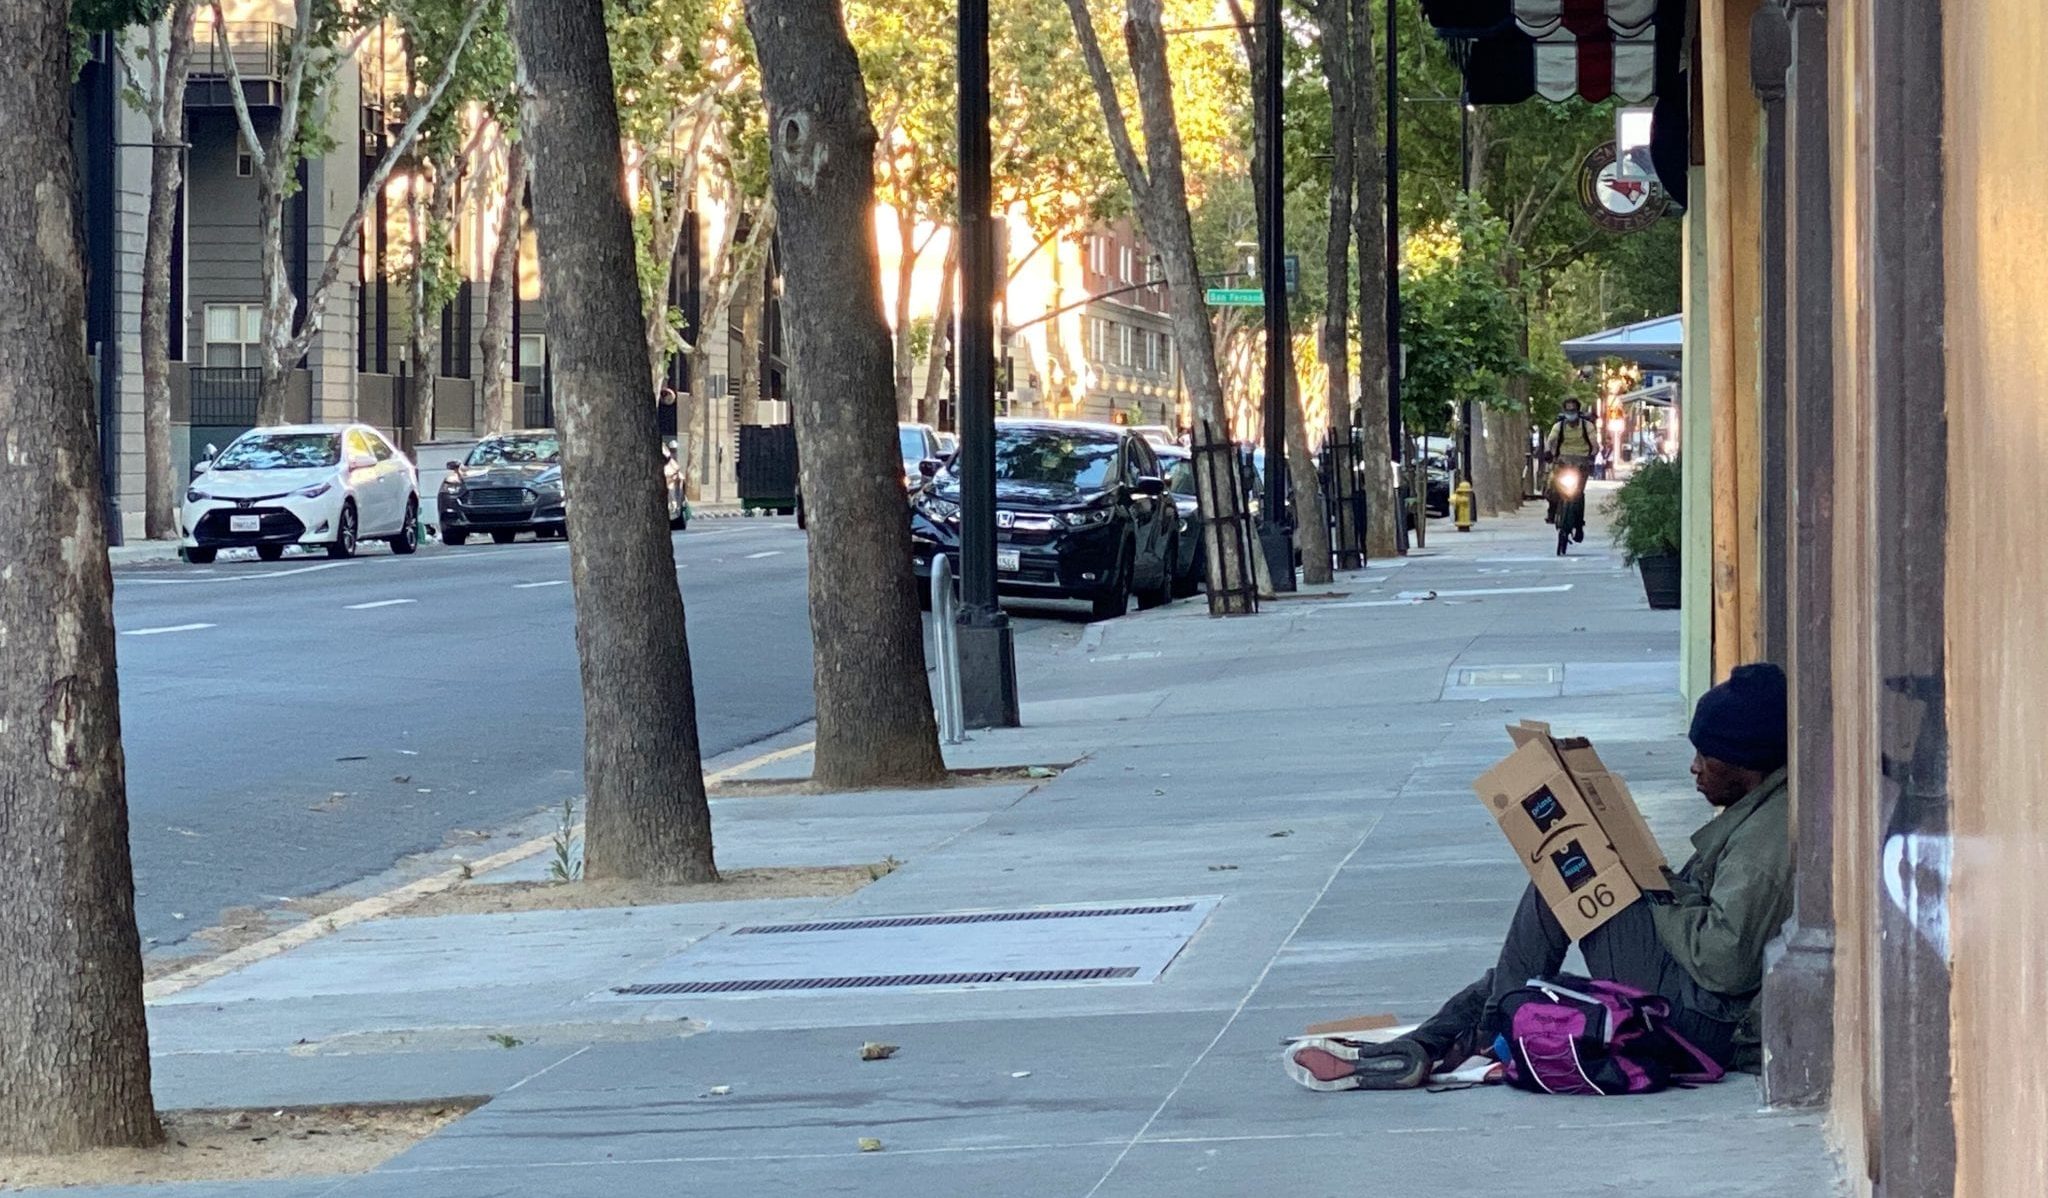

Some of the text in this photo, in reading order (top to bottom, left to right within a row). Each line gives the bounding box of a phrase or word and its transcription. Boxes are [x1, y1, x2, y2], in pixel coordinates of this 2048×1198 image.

[1210, 292, 1227, 301] San
[1531, 795, 1554, 817] prime
[1563, 857, 1588, 878] prime
